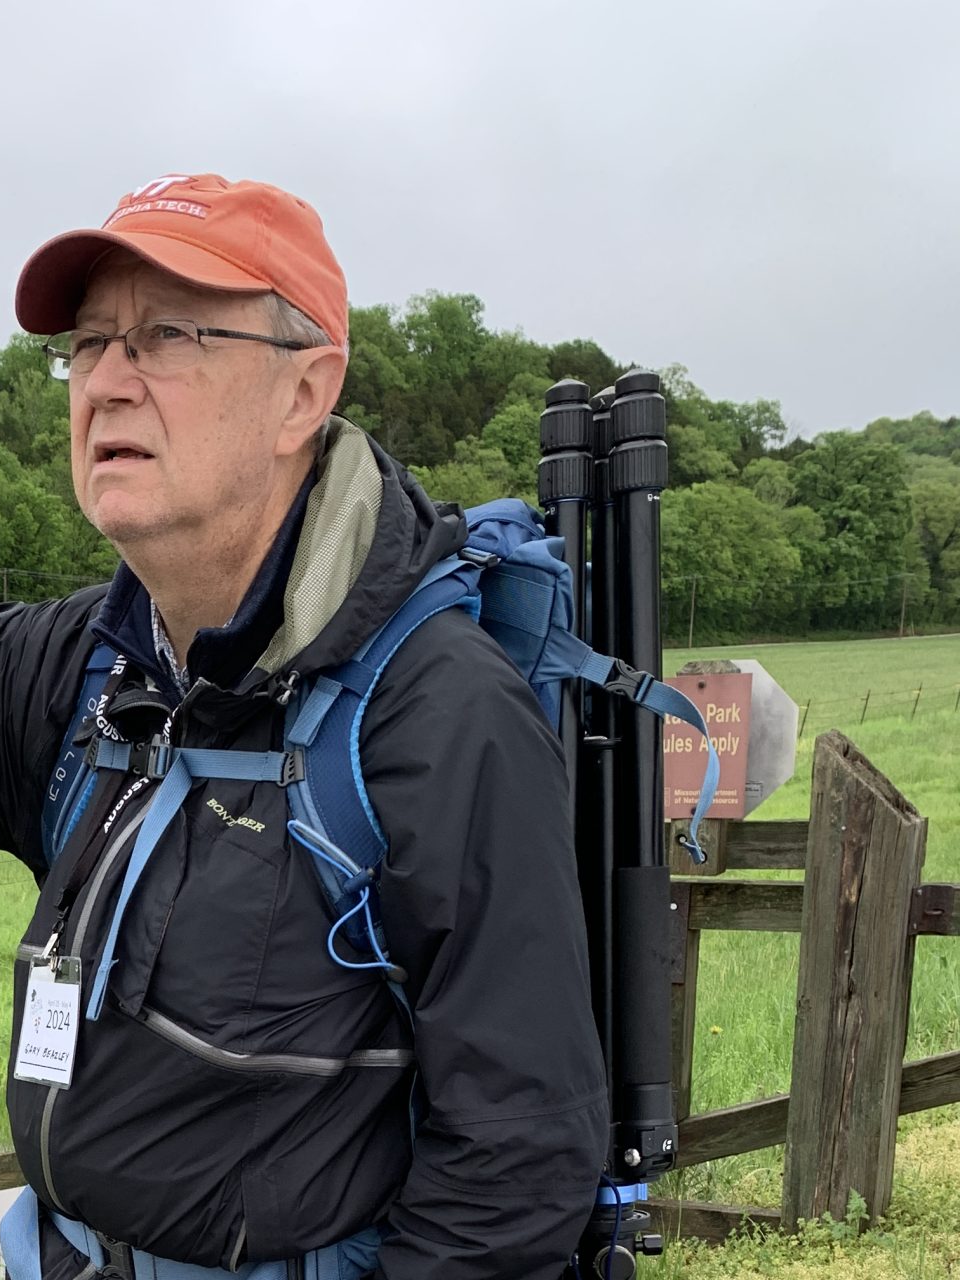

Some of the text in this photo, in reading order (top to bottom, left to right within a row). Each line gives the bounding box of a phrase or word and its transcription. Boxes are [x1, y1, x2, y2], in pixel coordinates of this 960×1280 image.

[155, 200, 203, 217] TECH
[706, 702, 741, 723] Park
[663, 733, 693, 753] ules
[46, 1009, 71, 1031] 2024
